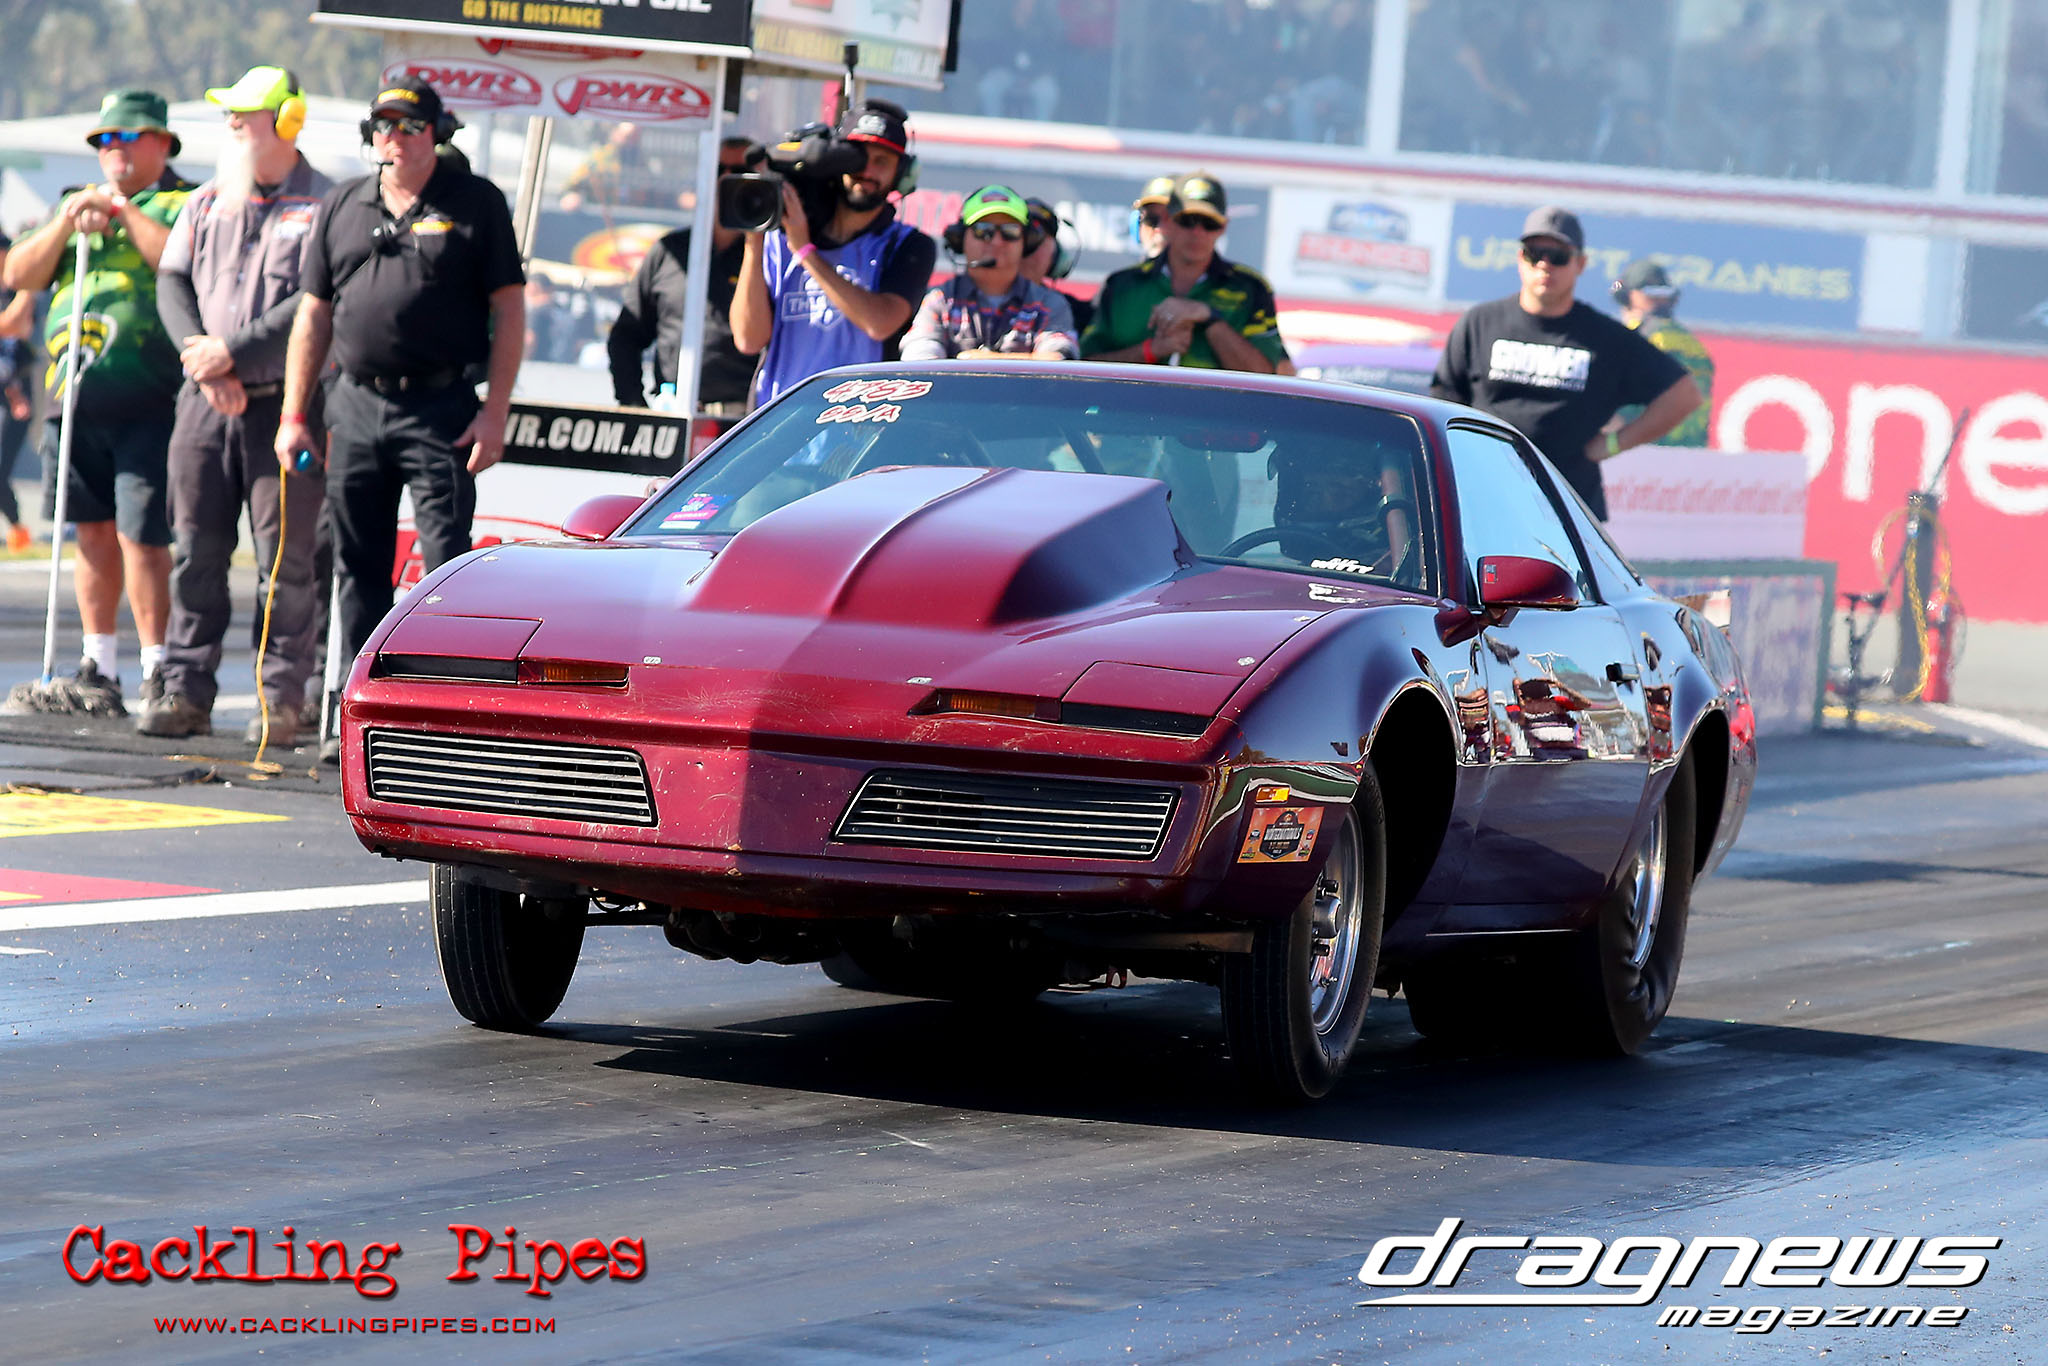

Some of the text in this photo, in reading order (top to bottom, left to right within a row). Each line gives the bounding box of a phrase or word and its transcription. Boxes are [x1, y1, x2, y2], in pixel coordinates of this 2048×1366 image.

[462, 0, 487, 20] GO
[490, 2, 520, 22] THE
[523, 5, 604, 29] DISTANCE
[559, 78, 690, 115] PWR
